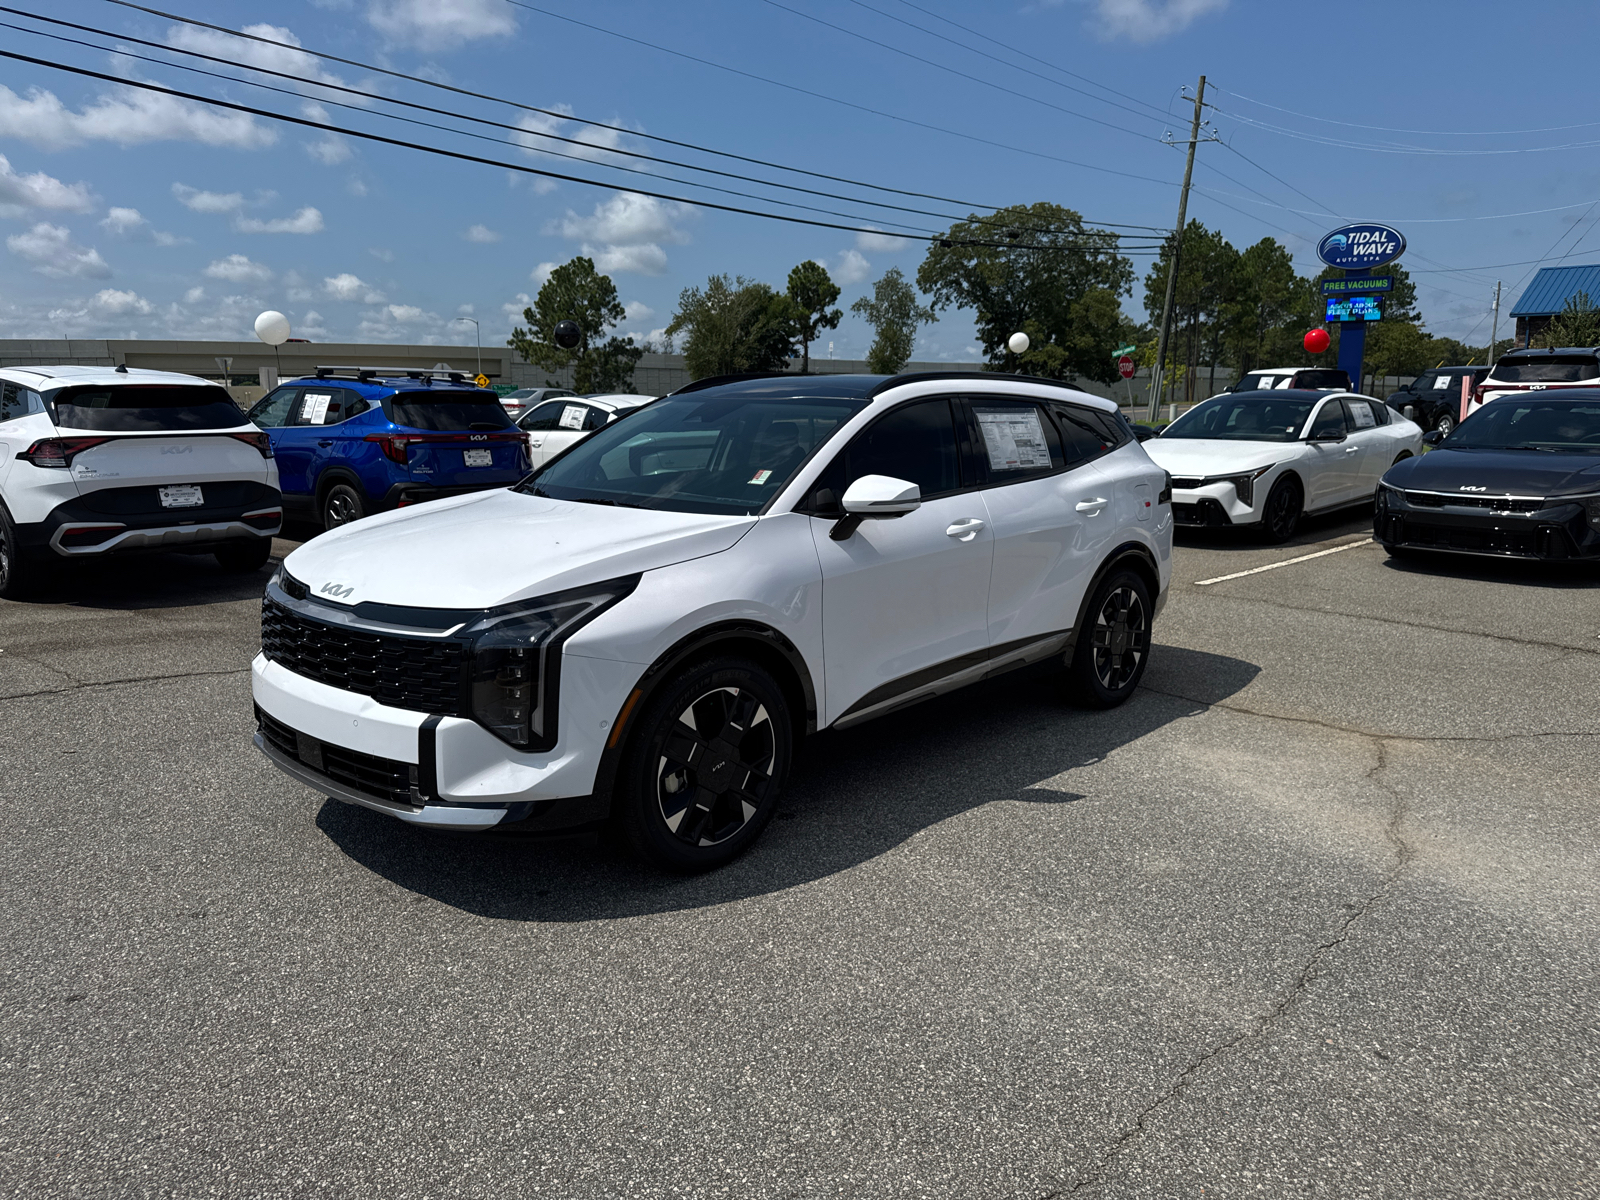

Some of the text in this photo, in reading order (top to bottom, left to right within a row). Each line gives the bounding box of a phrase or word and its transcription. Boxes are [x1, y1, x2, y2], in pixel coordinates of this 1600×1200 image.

[1348, 231, 1388, 244] TIDAL
[1353, 242, 1396, 255] WAVE
[1324, 279, 1388, 290] FREE VACUUMS
[1352, 307, 1379, 315] PLANS
[1120, 362, 1133, 372] STOP
[160, 445, 193, 455] KIA
[320, 581, 355, 598] KIA
[669, 675, 712, 717] MICHELIN
